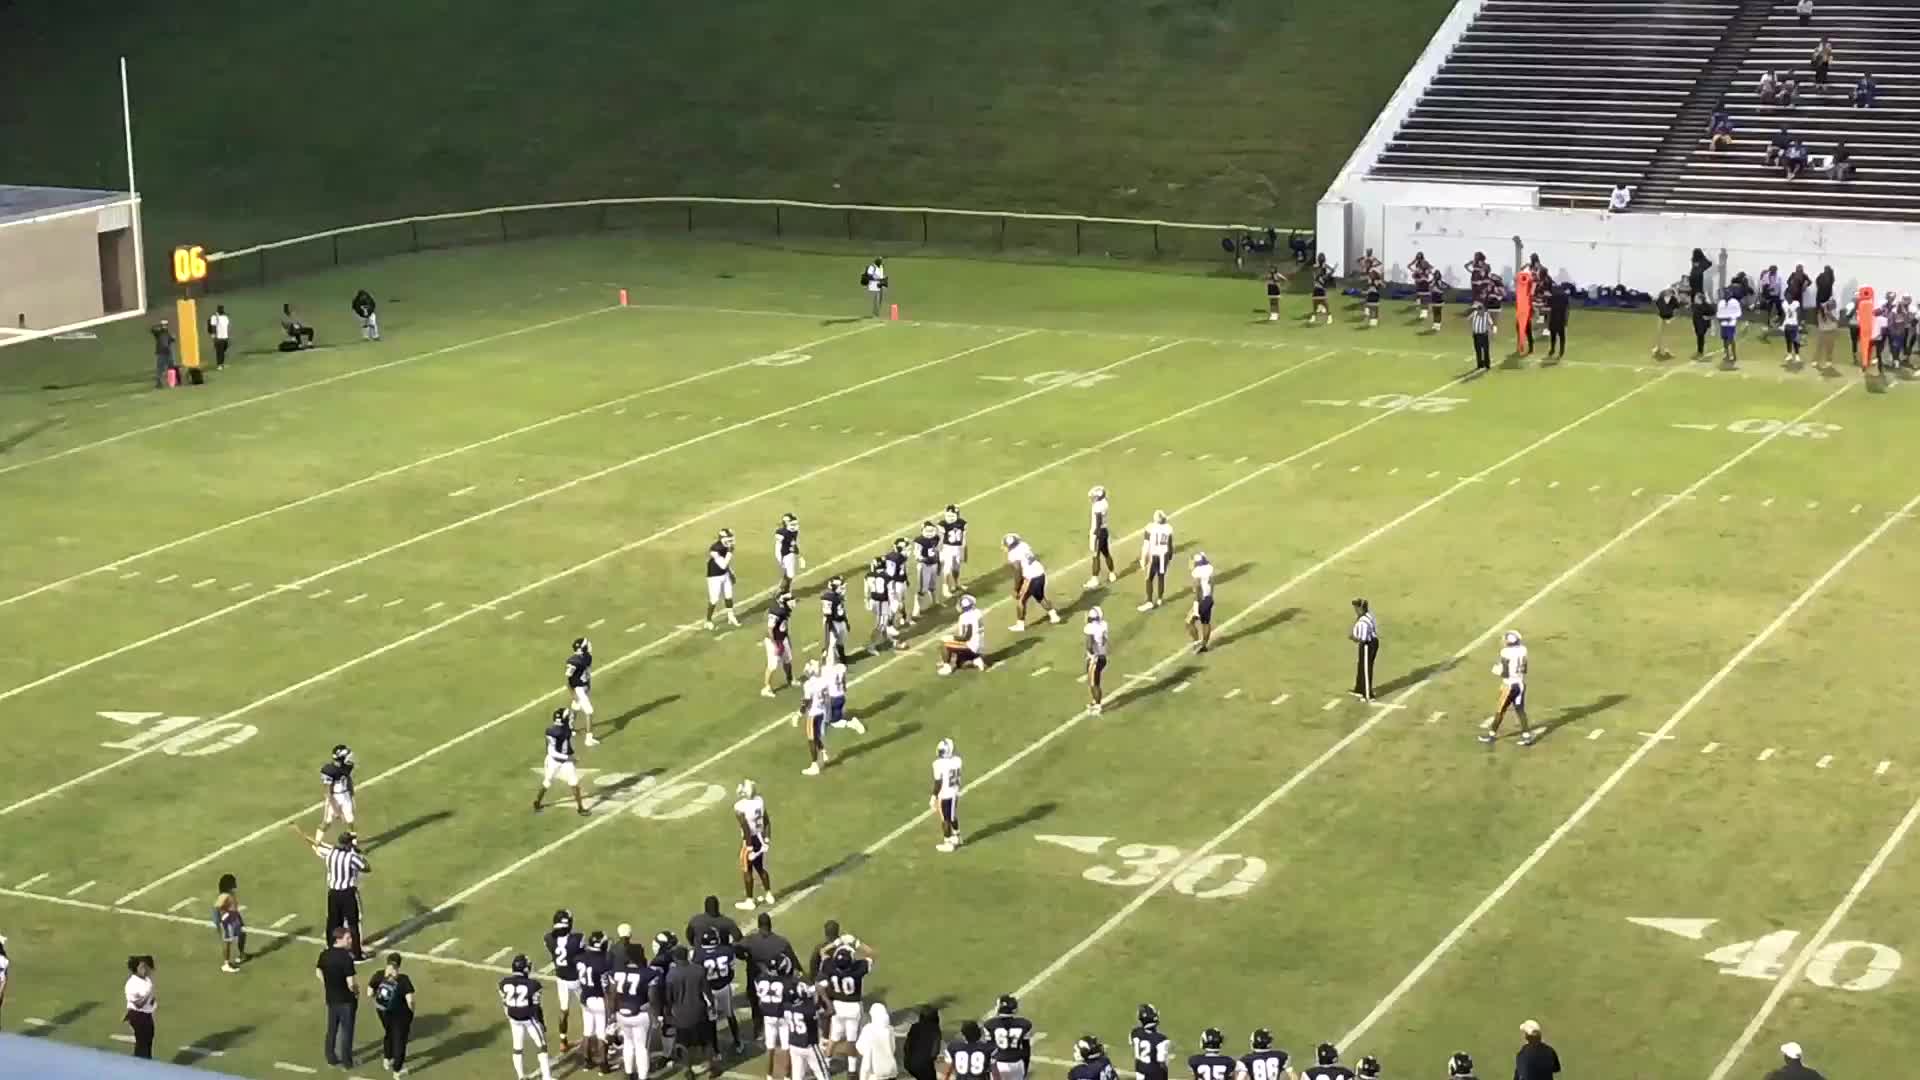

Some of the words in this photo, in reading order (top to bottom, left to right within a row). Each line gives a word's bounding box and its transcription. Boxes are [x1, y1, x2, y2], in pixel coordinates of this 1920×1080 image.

[174, 246, 207, 283] 06
[100, 716, 259, 757] 10
[554, 772, 728, 821] 20
[1082, 843, 1268, 898] 30
[703, 955, 729, 982] 25
[1703, 929, 1902, 991] 40
[576, 961, 595, 987] 21
[614, 972, 641, 996] 77
[830, 975, 856, 995] 10
[502, 983, 529, 1008] 22
[994, 1027, 1023, 1049] 67
[1133, 1037, 1151, 1064] 12
